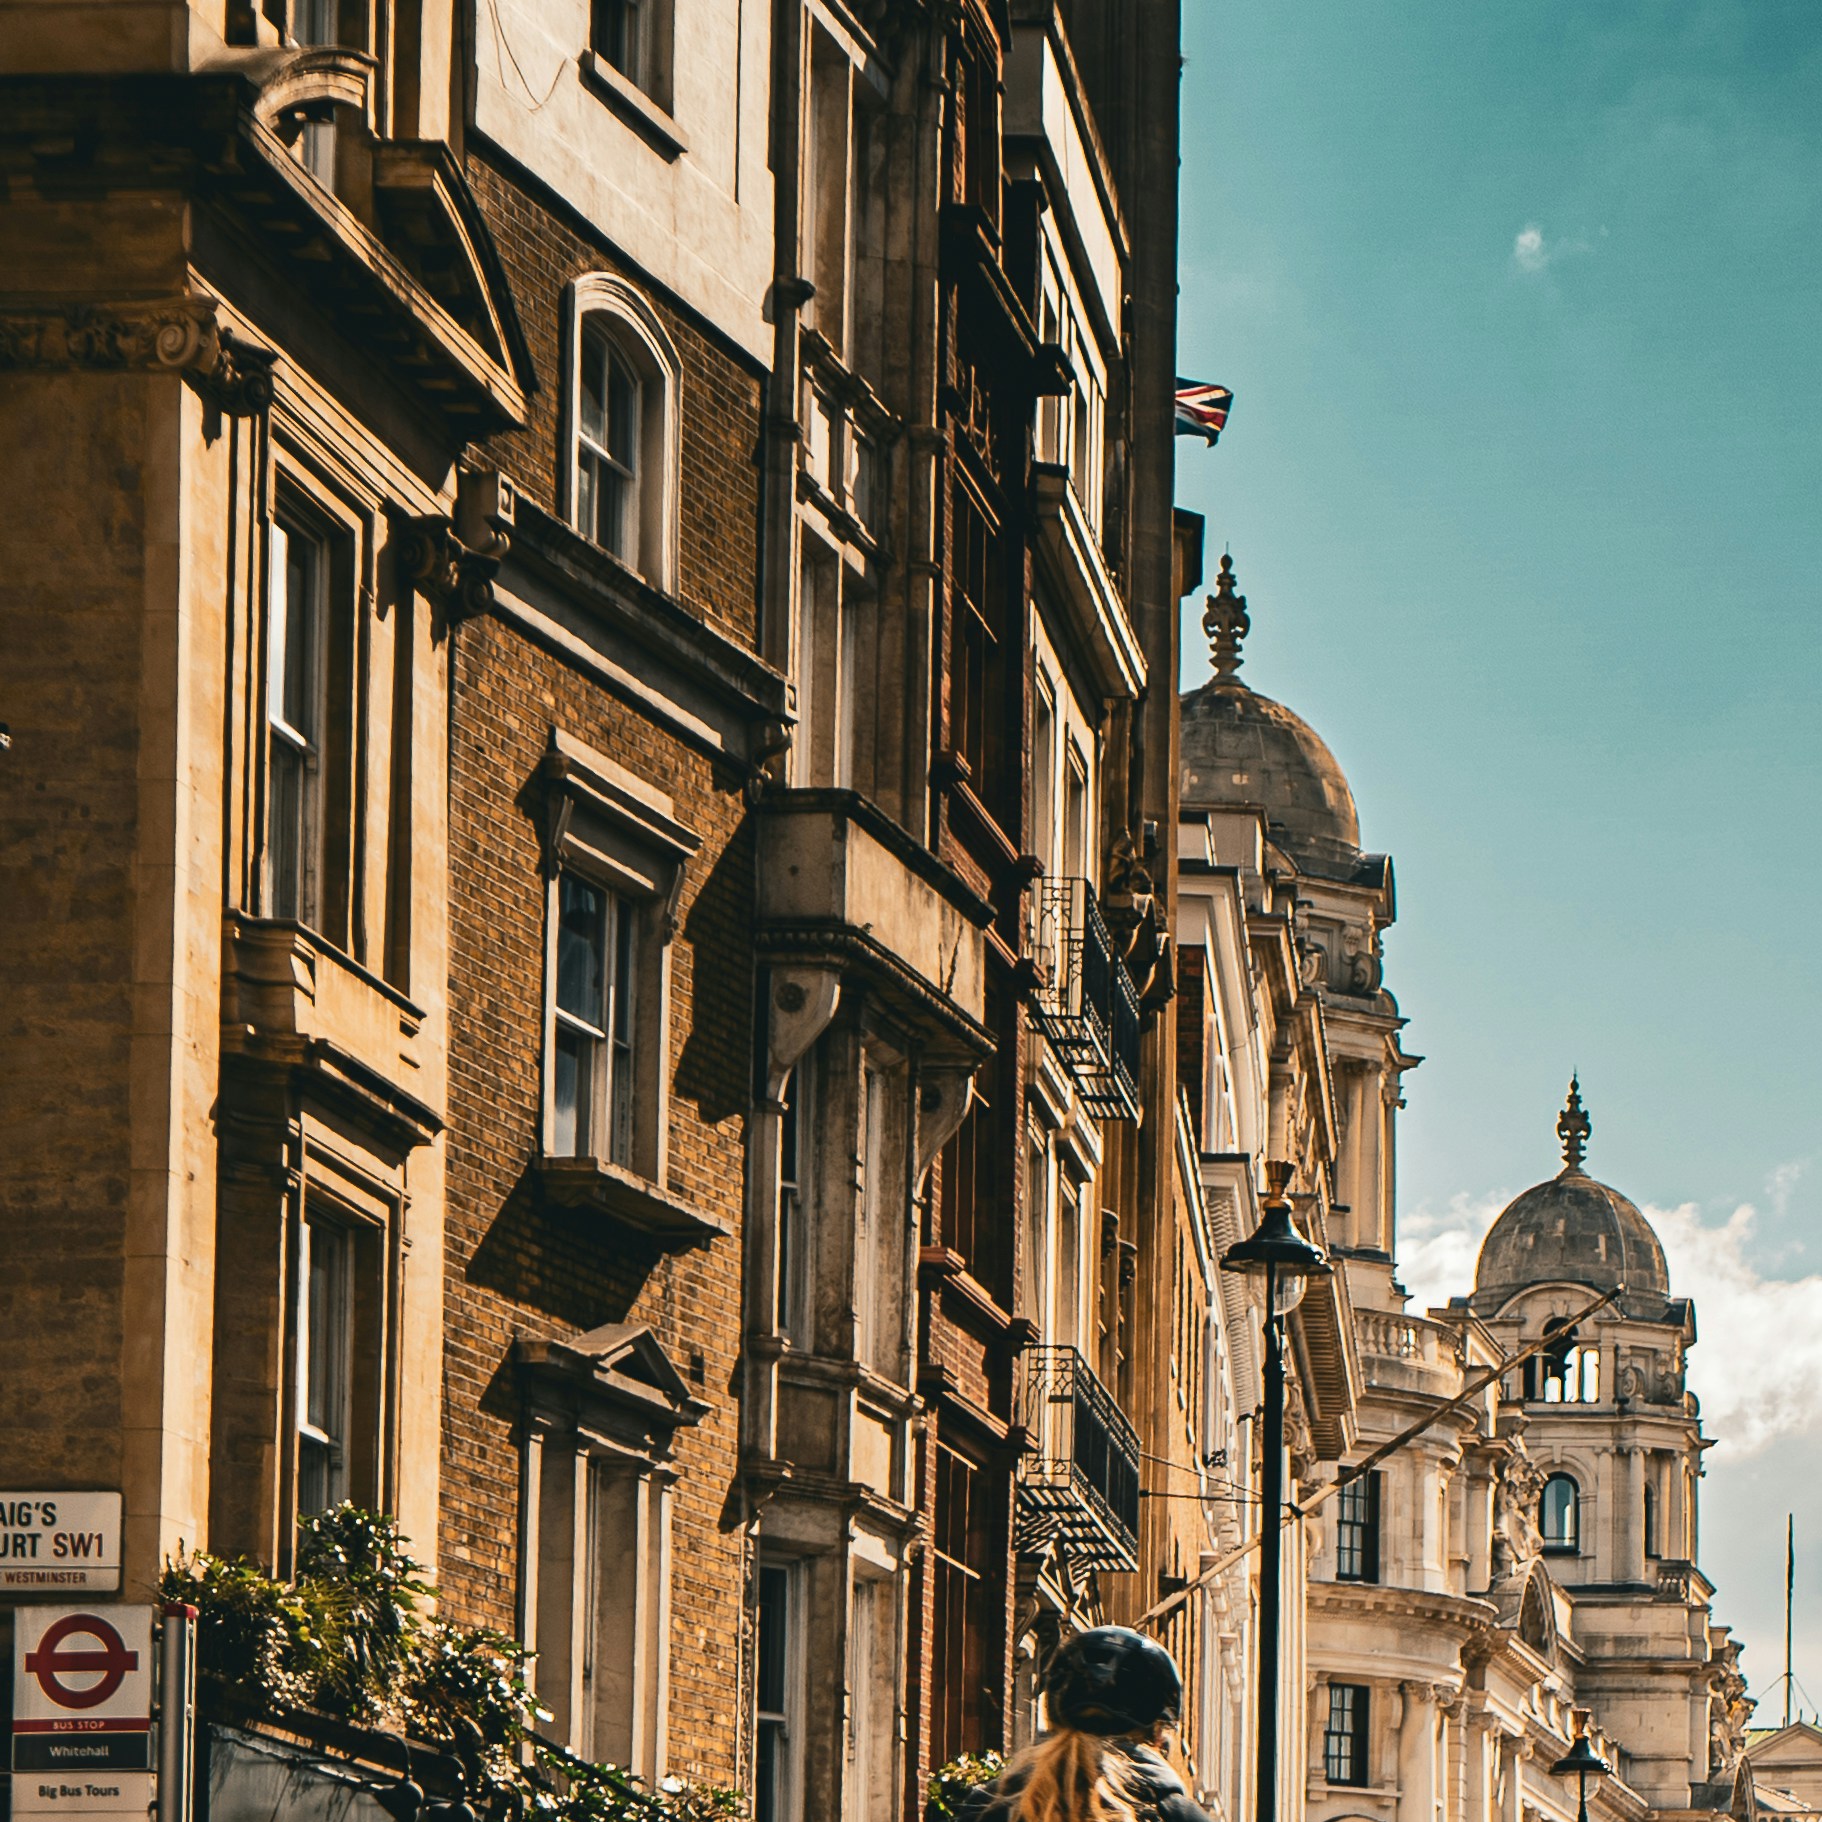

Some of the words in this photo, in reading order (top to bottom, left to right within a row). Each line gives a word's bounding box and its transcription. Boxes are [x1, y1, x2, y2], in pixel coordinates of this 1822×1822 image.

[53, 1532, 103, 1558] SW1
[5, 1571, 86, 1584] WESTMINSTER
[53, 1721, 74, 1730] BUS
[77, 1720, 105, 1730] STOP
[49, 1745, 109, 1757] Whitehall
[38, 1785, 57, 1799] Big
[60, 1785, 82, 1797] Bus
[85, 1784, 120, 1797] Tours
